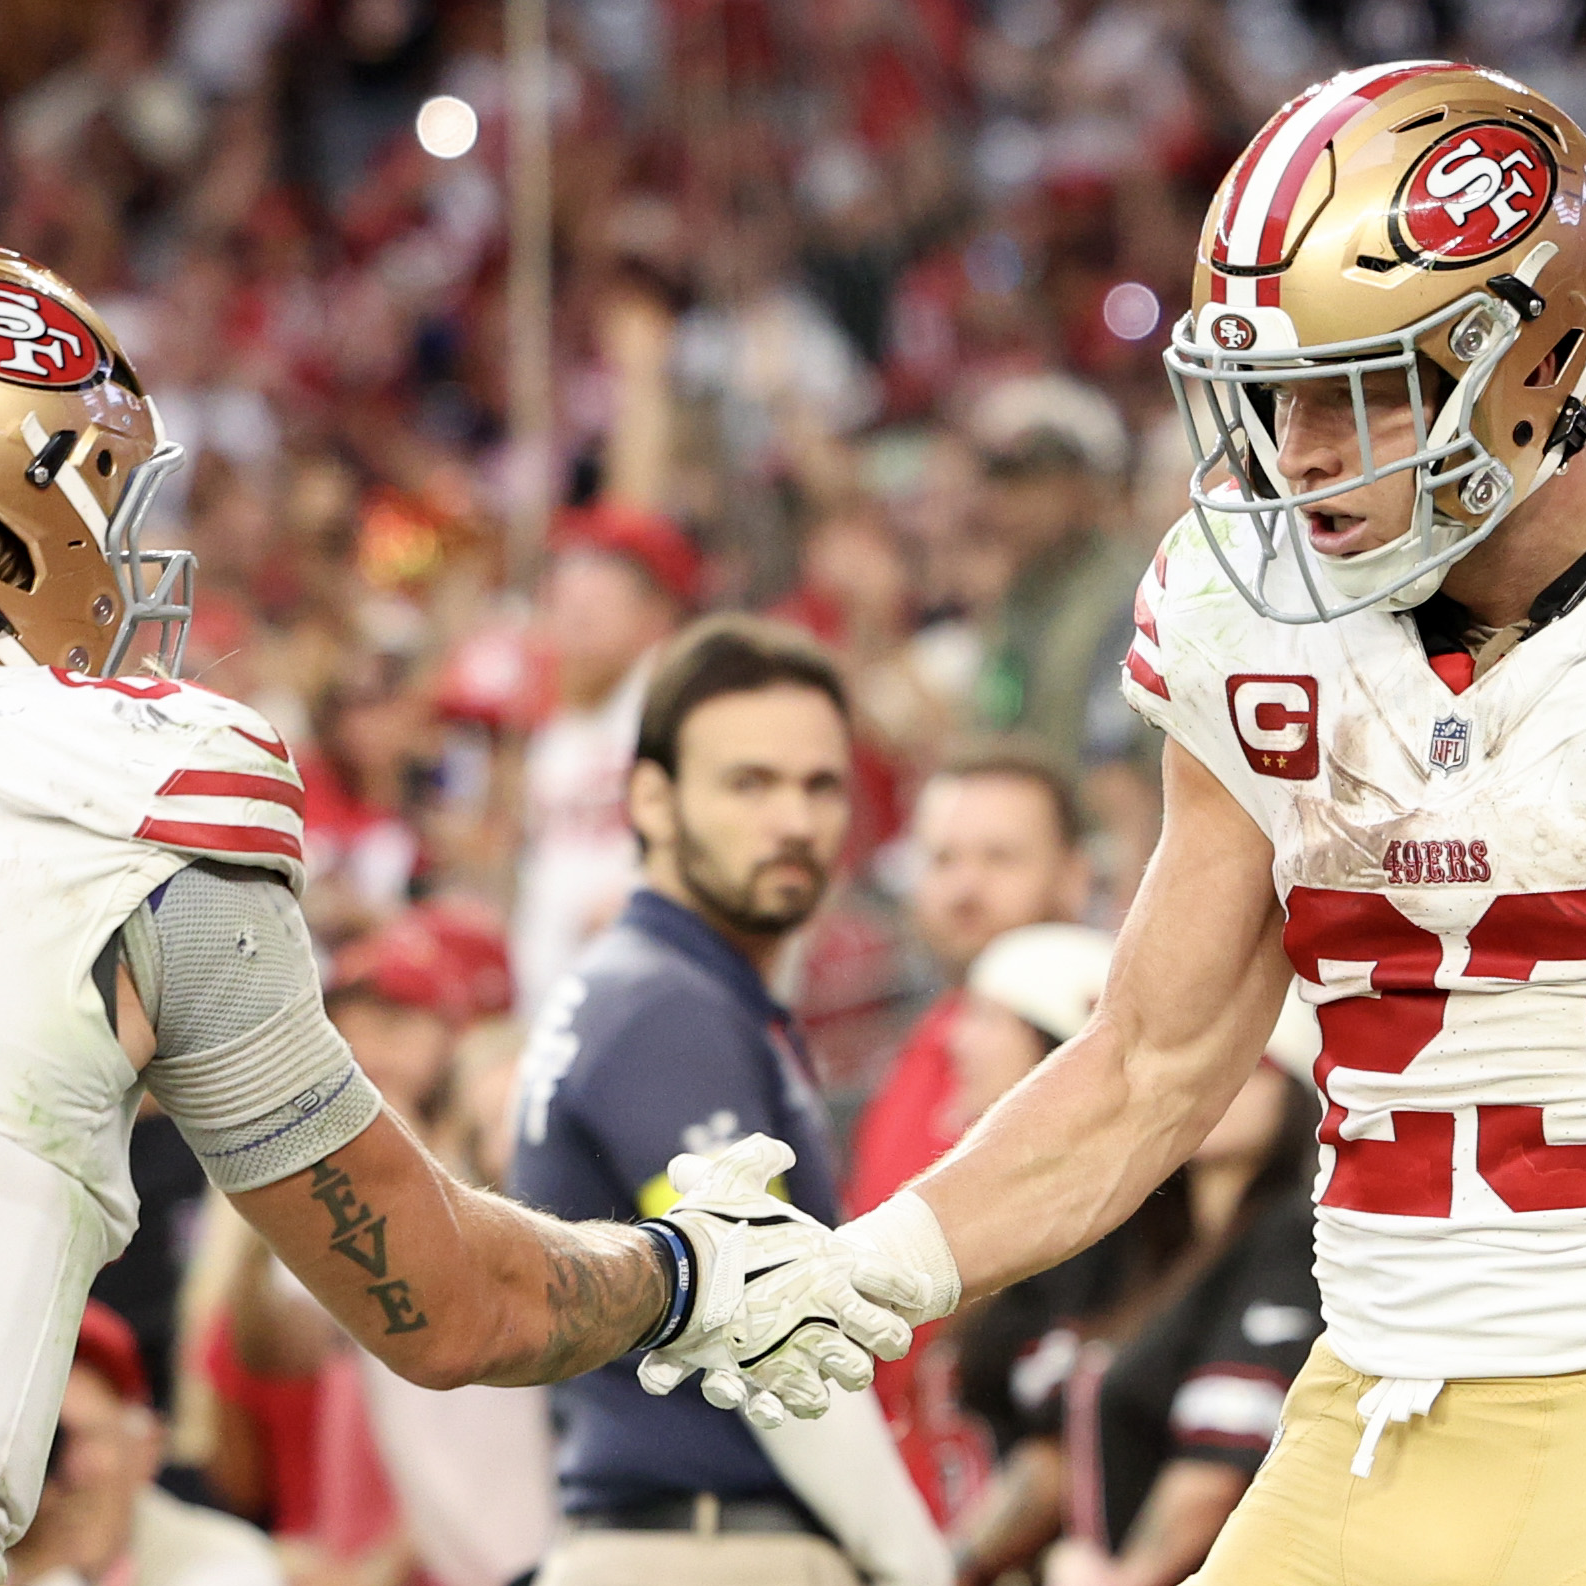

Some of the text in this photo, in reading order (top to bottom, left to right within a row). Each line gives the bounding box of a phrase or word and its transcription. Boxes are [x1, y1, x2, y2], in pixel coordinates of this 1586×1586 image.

[1234, 682, 1309, 752] C
[1432, 740, 1462, 765] NFL
[1382, 839, 1492, 885] 49ERS
